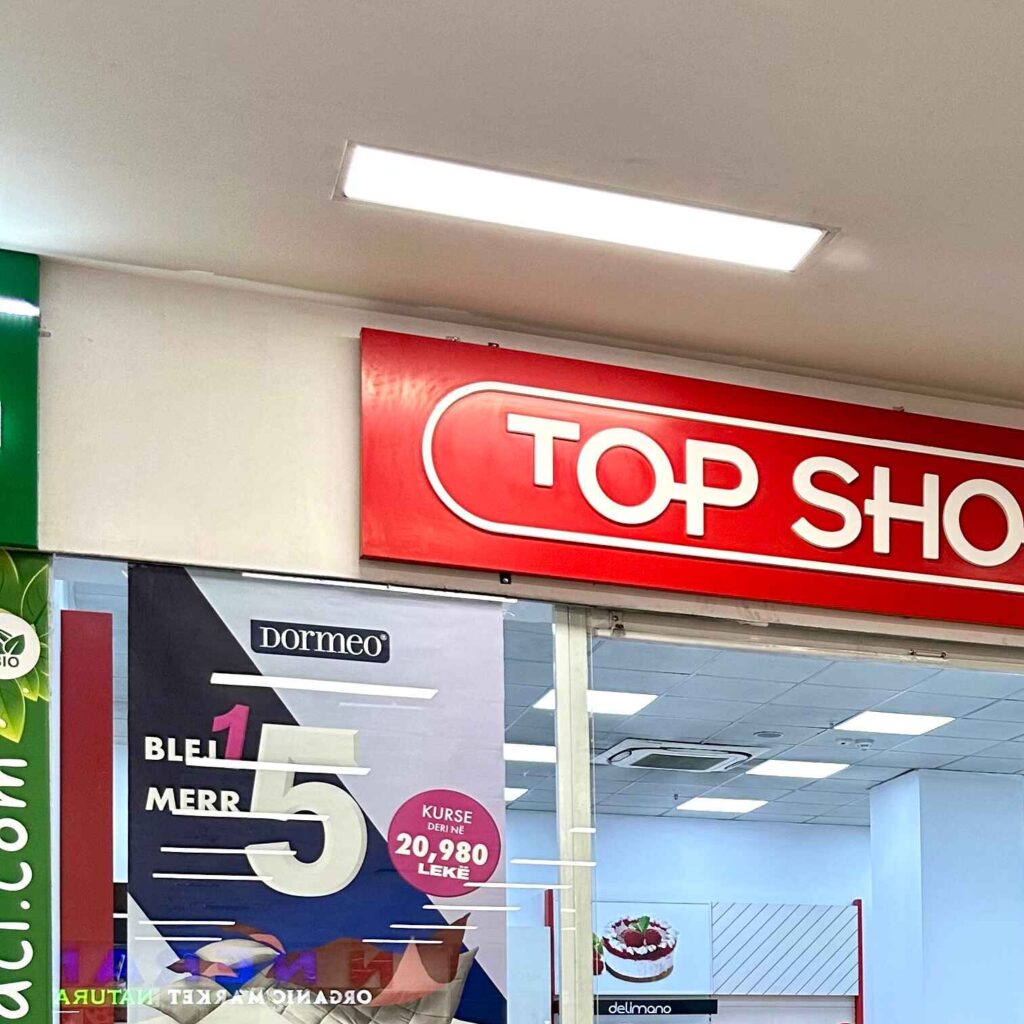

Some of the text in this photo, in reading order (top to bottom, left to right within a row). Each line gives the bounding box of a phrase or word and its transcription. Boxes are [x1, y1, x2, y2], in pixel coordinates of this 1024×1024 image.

[505, 412, 760, 538] TOP
[259, 627, 384, 659] Dormeo
[0, 656, 20, 668] IO
[145, 704, 250, 762] BLEJ 1
[145, 723, 368, 898] MERR 5
[422, 804, 473, 825] KURSE
[427, 822, 449, 833] DERI
[395, 832, 489, 866] 20,980
[417, 862, 471, 880] LEKË
[608, 1001, 672, 1014] delimano
